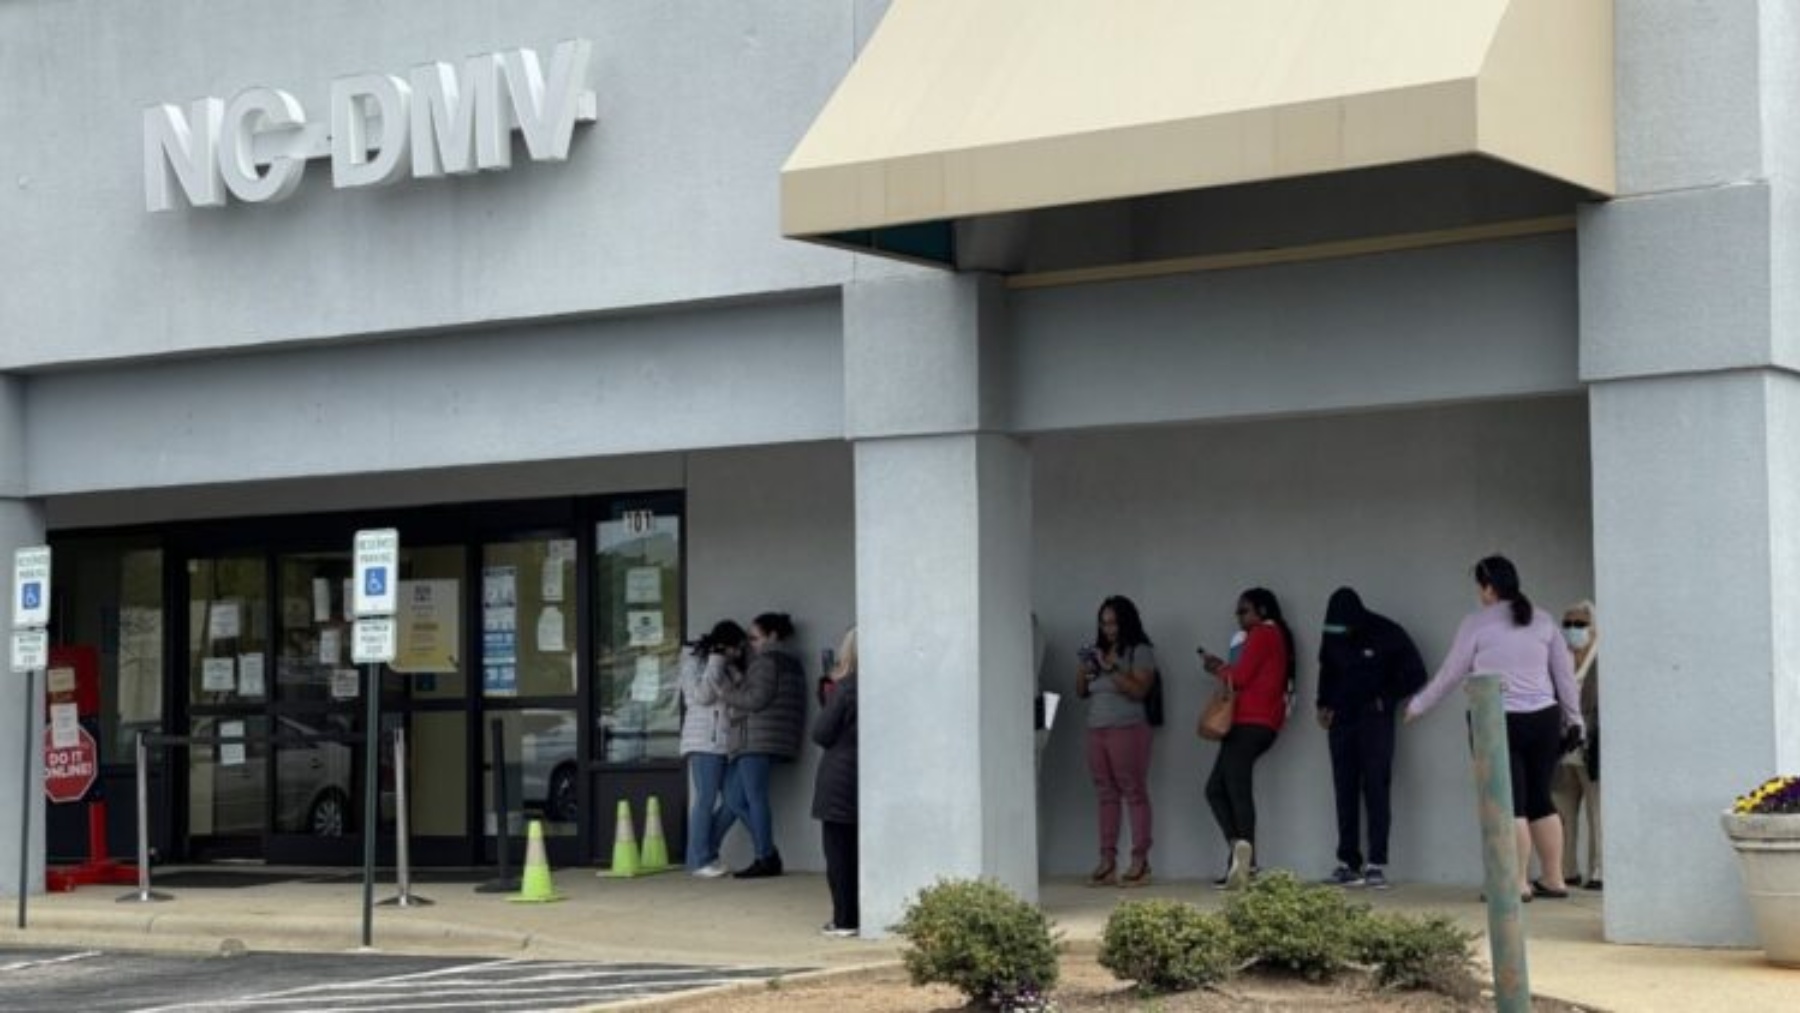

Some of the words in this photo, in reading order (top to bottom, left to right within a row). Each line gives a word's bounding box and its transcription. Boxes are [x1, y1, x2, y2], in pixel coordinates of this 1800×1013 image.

[144, 86, 306, 212] NC
[331, 38, 593, 189] DMV
[625, 511, 651, 533] 101
[49, 752, 69, 766] DO
[71, 750, 83, 765] IT
